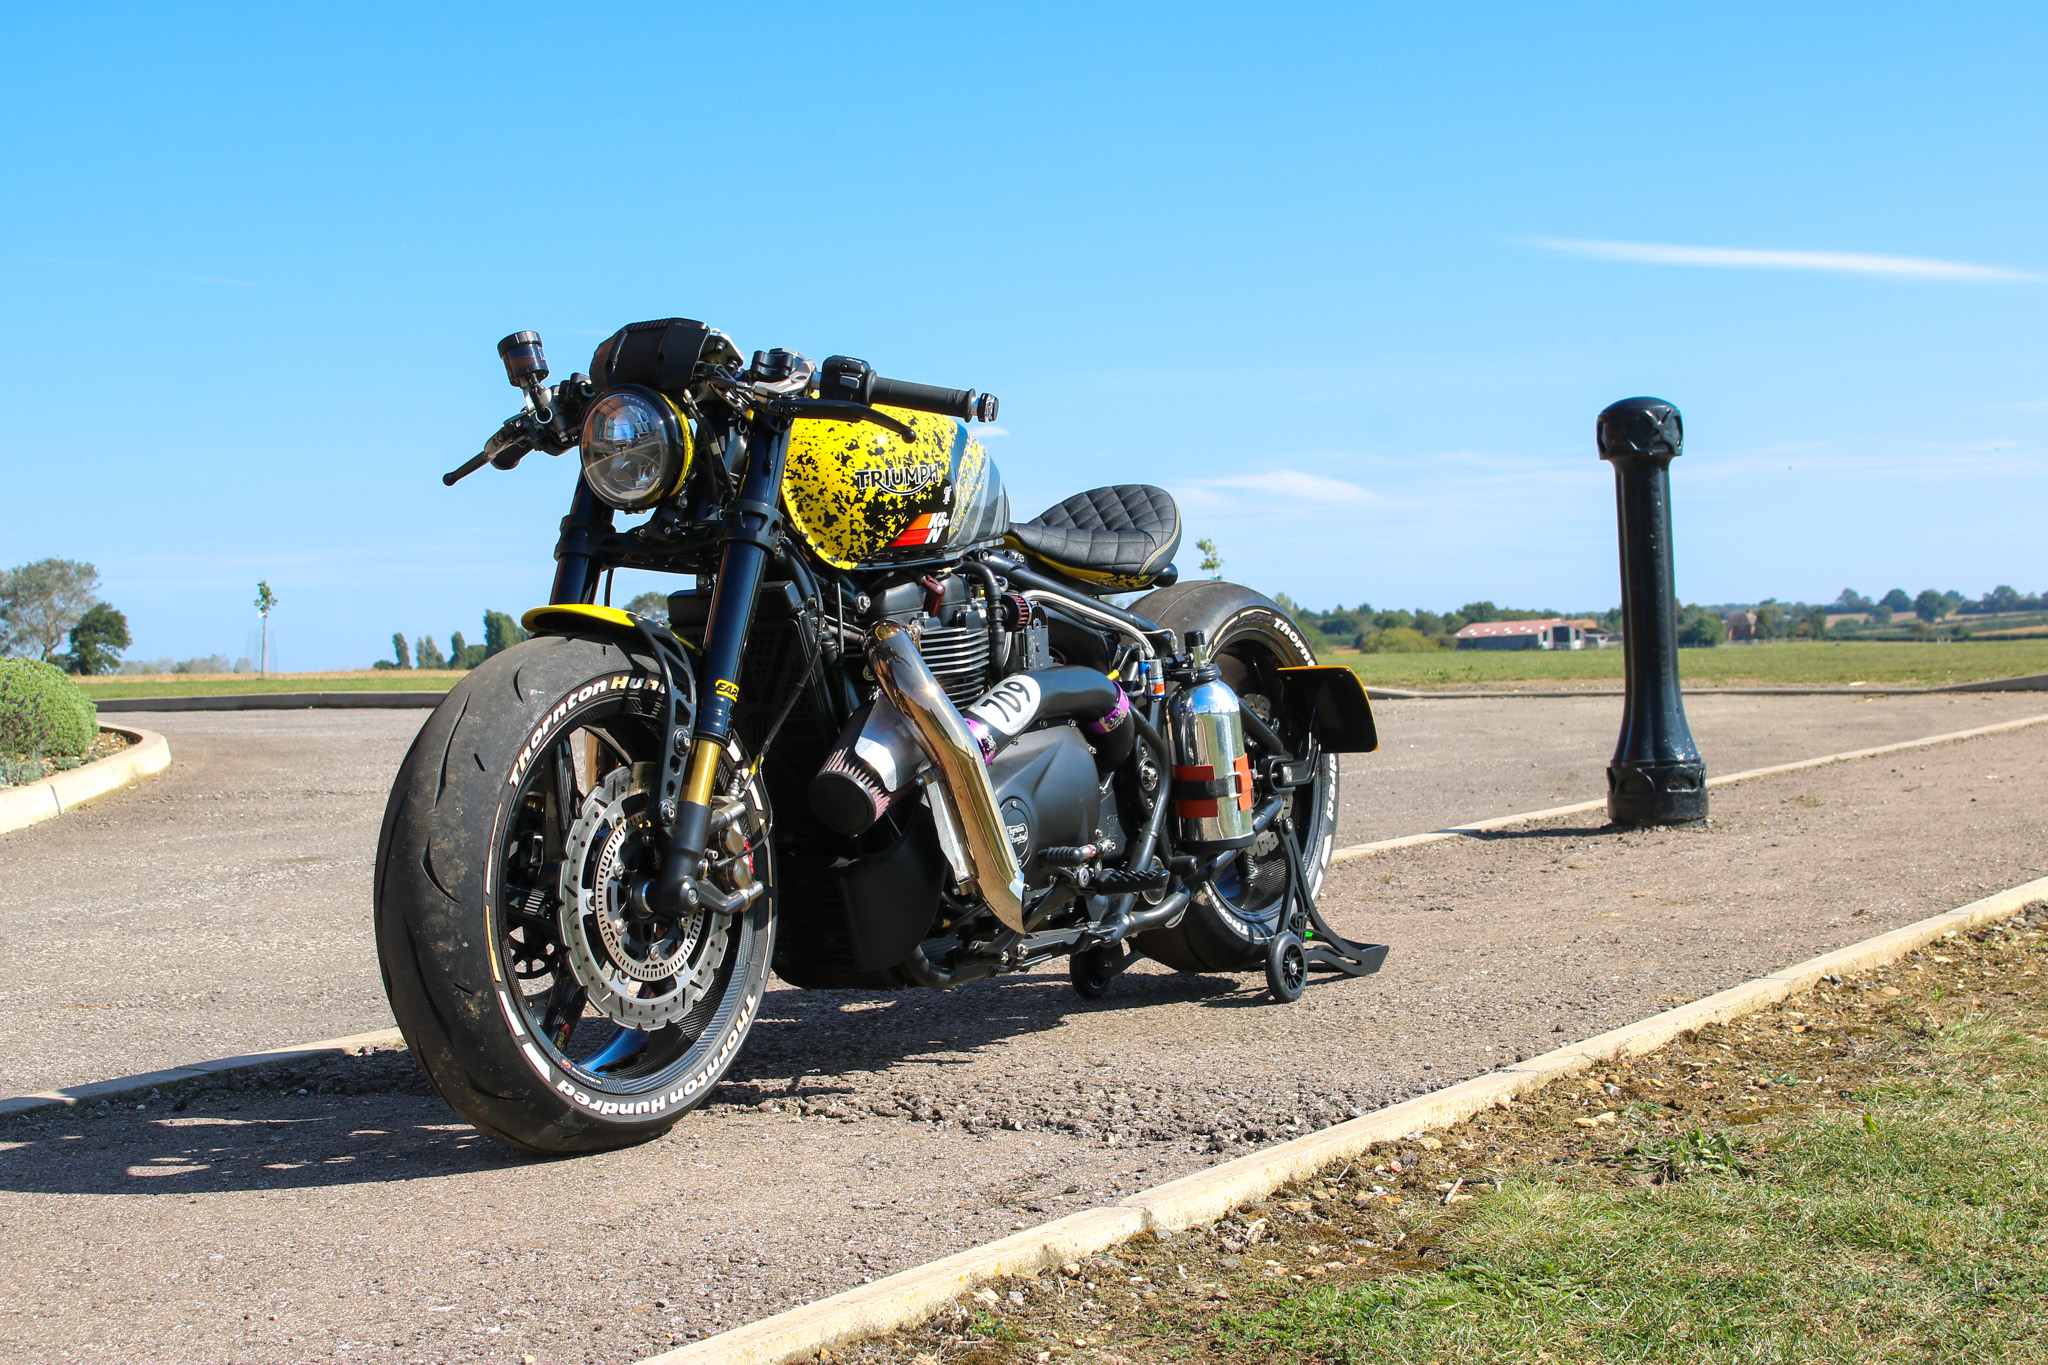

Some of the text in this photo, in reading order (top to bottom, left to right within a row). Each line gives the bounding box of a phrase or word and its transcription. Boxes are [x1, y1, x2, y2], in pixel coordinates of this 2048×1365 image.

[854, 464, 940, 495] TRIUMPH
[508, 679, 608, 787] Thornton
[980, 681, 1031, 722] 709
[555, 994, 757, 1115] Thornton Hundred
